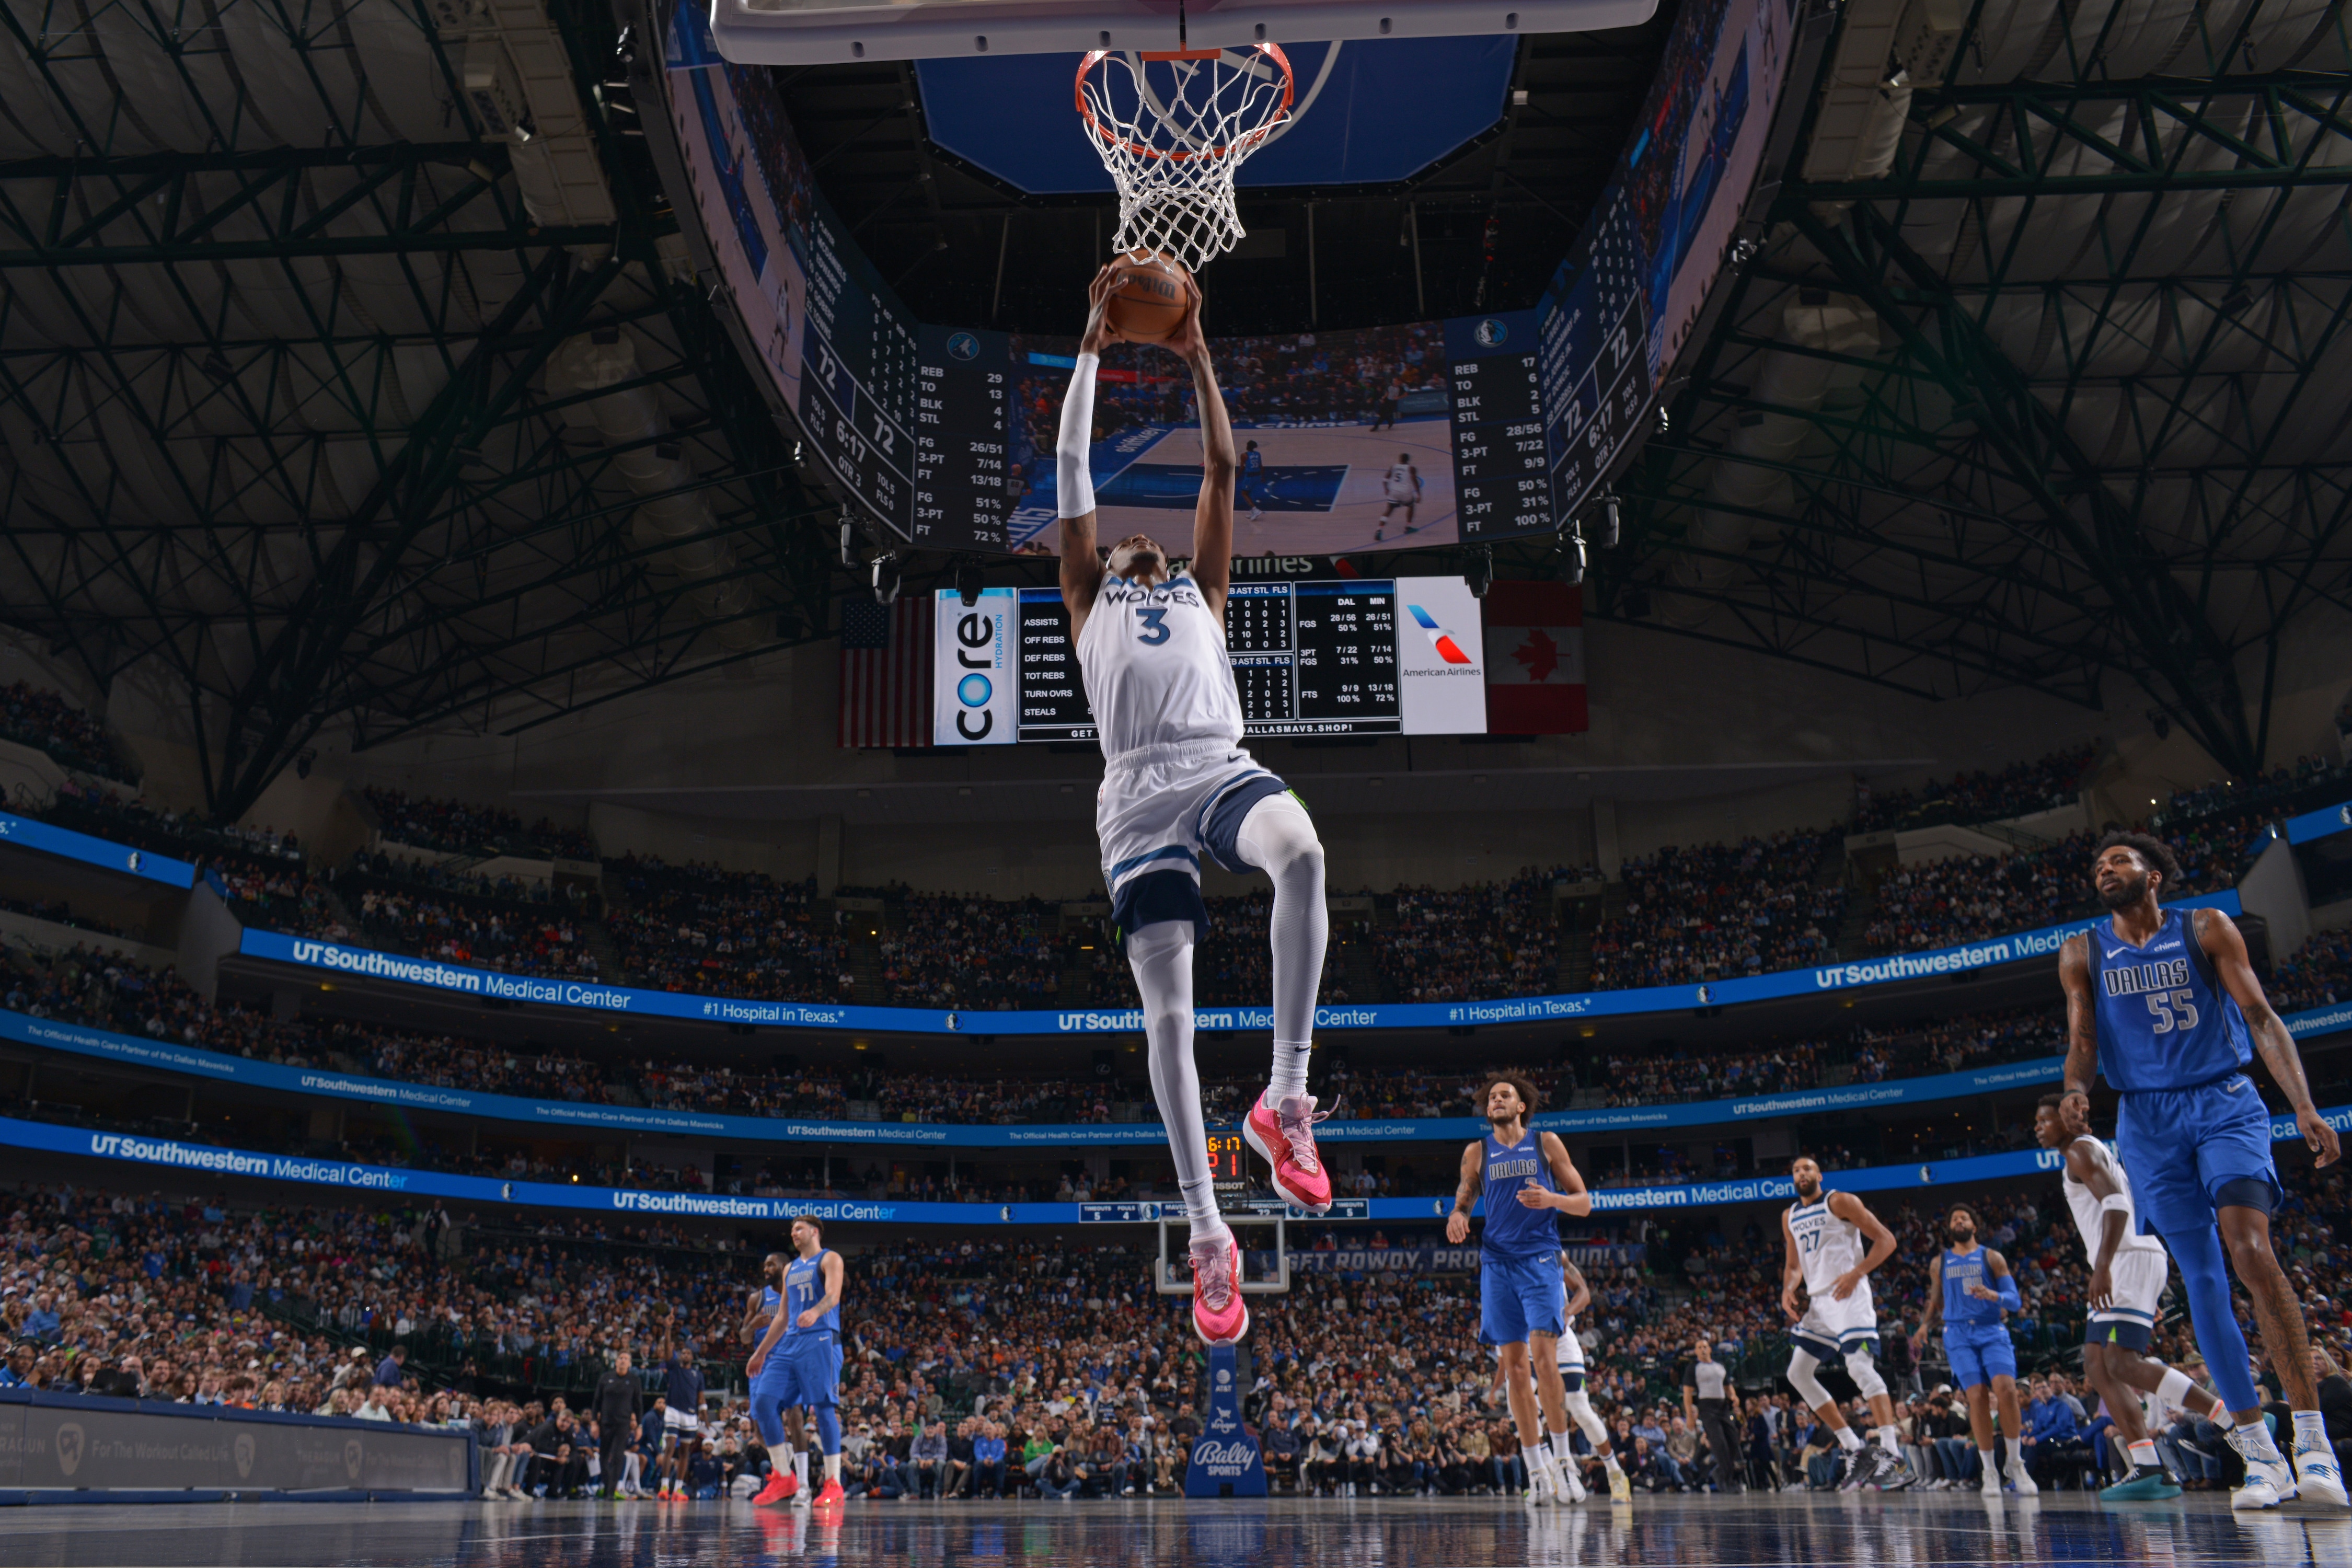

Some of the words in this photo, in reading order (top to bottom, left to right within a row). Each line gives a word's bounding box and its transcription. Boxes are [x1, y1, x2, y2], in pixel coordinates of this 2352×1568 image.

[1611, 326, 1629, 369] 72
[820, 344, 836, 390] 72
[1455, 364, 1478, 375] REB
[1522, 357, 1535, 367] 17
[921, 366, 943, 377] REB
[988, 373, 1002, 383] 29
[920, 382, 936, 391] TO
[989, 389, 1002, 399] 13
[1456, 381, 1472, 390] TO
[920, 398, 942, 409] BLK
[1458, 397, 1480, 408] BLK
[920, 413, 939, 423] STL
[1255, 421, 1358, 429] chime
[1459, 412, 1479, 422] STL
[1564, 399, 1582, 439] 72
[1589, 400, 1612, 448] 6:17
[836, 420, 866, 463] 6:17
[874, 413, 893, 455] 72
[1115, 425, 1168, 453] shiftkey
[1460, 432, 1475, 442] FG
[1506, 423, 1542, 436] 28/56
[919, 437, 933, 447] FG
[970, 442, 1002, 454] 26/51
[1461, 446, 1488, 458] 3-PT
[1516, 440, 1543, 452] 7/22
[838, 456, 854, 479] QTR
[919, 453, 944, 464] 3-PT
[977, 458, 1001, 469] 7/14
[1463, 465, 1476, 475] FT
[1525, 457, 1544, 468] 9/9
[918, 469, 932, 479] FT
[971, 475, 1001, 486] 13/18
[918, 492, 932, 502] FG
[1465, 488, 1480, 498] FG
[917, 508, 943, 519] 3-PT
[1466, 502, 1492, 514] 3-PT
[917, 525, 930, 535] FT
[1467, 521, 1481, 532] FT
[1136, 608, 1170, 646] 3
[956, 613, 993, 740] core
[1244, 723, 1352, 733] ALLASMAVS.SHOP!
[2153, 940, 2181, 952] chime
[294, 941, 479, 990] UTSouthwestern
[486, 976, 562, 1001] Medical
[567, 986, 630, 1008] Center
[1817, 944, 2009, 987] UTSouthwestern
[2103, 958, 2189, 997] DALLAS
[704, 1003, 718, 1015] #1
[723, 1004, 779, 1021] Hospital
[783, 1008, 795, 1020] in
[1316, 1009, 1377, 1025] Center
[1450, 1008, 1464, 1020] #1
[1470, 1003, 1525, 1021] Hospital
[1529, 1003, 1541, 1015] in
[2146, 989, 2198, 1034] 55
[1059, 1012, 1232, 1030] UTSouthtern
[28, 1025, 42, 1035] The
[44, 1030, 72, 1041] Official
[74, 1035, 99, 1046] Health
[101, 1041, 120, 1051] Care
[121, 1044, 149, 1056] Partner
[174, 1054, 196, 1065] Dallas
[198, 1059, 234, 1072] Mavericks
[302, 1076, 396, 1097] UTSouthwestern
[399, 1089, 437, 1103] Medical
[439, 1094, 470, 1107] Center
[1734, 1097, 1826, 1114] UTSouthwestern
[1828, 1091, 1868, 1103] Medical
[1870, 1089, 1903, 1100] Center
[551, 1109, 575, 1117] Official
[619, 1114, 644, 1123] Partner
[690, 1121, 723, 1129] Mavericks
[788, 1126, 875, 1137] UTSouthwestern
[878, 1129, 914, 1138] Medical
[916, 1130, 946, 1139] Center
[1346, 1127, 1383, 1135] Medical
[1385, 1126, 1415, 1135] Center
[1208, 1137, 1240, 1152] 6:17
[91, 1135, 268, 1174] UTSouthwestern
[273, 1159, 345, 1182] Medical
[349, 1167, 408, 1189] Center
[1489, 1159, 1537, 1181] DALLAS
[1590, 1189, 1686, 1208] thwestern
[1692, 1183, 1758, 1203] Medical
[614, 1192, 767, 1216] UTSouthwestern
[774, 1202, 838, 1219] Medical
[841, 1204, 895, 1219] Center
[1346, 1208, 1353, 1217] 5
[1123, 1212, 1129, 1220] 4
[1793, 1216, 1826, 1232] WOLVES
[1800, 1230, 1820, 1253] 27
[1335, 1251, 1424, 1272] ROWDY,
[797, 1282, 813, 1302] 77
[1211, 1418, 1237, 1434] Kroger
[92, 1440, 111, 1458] For
[114, 1441, 132, 1458] The
[135, 1443, 178, 1460] Workout
[1194, 1440, 1256, 1471] Bally
[1208, 1466, 1241, 1476] SPORTS
